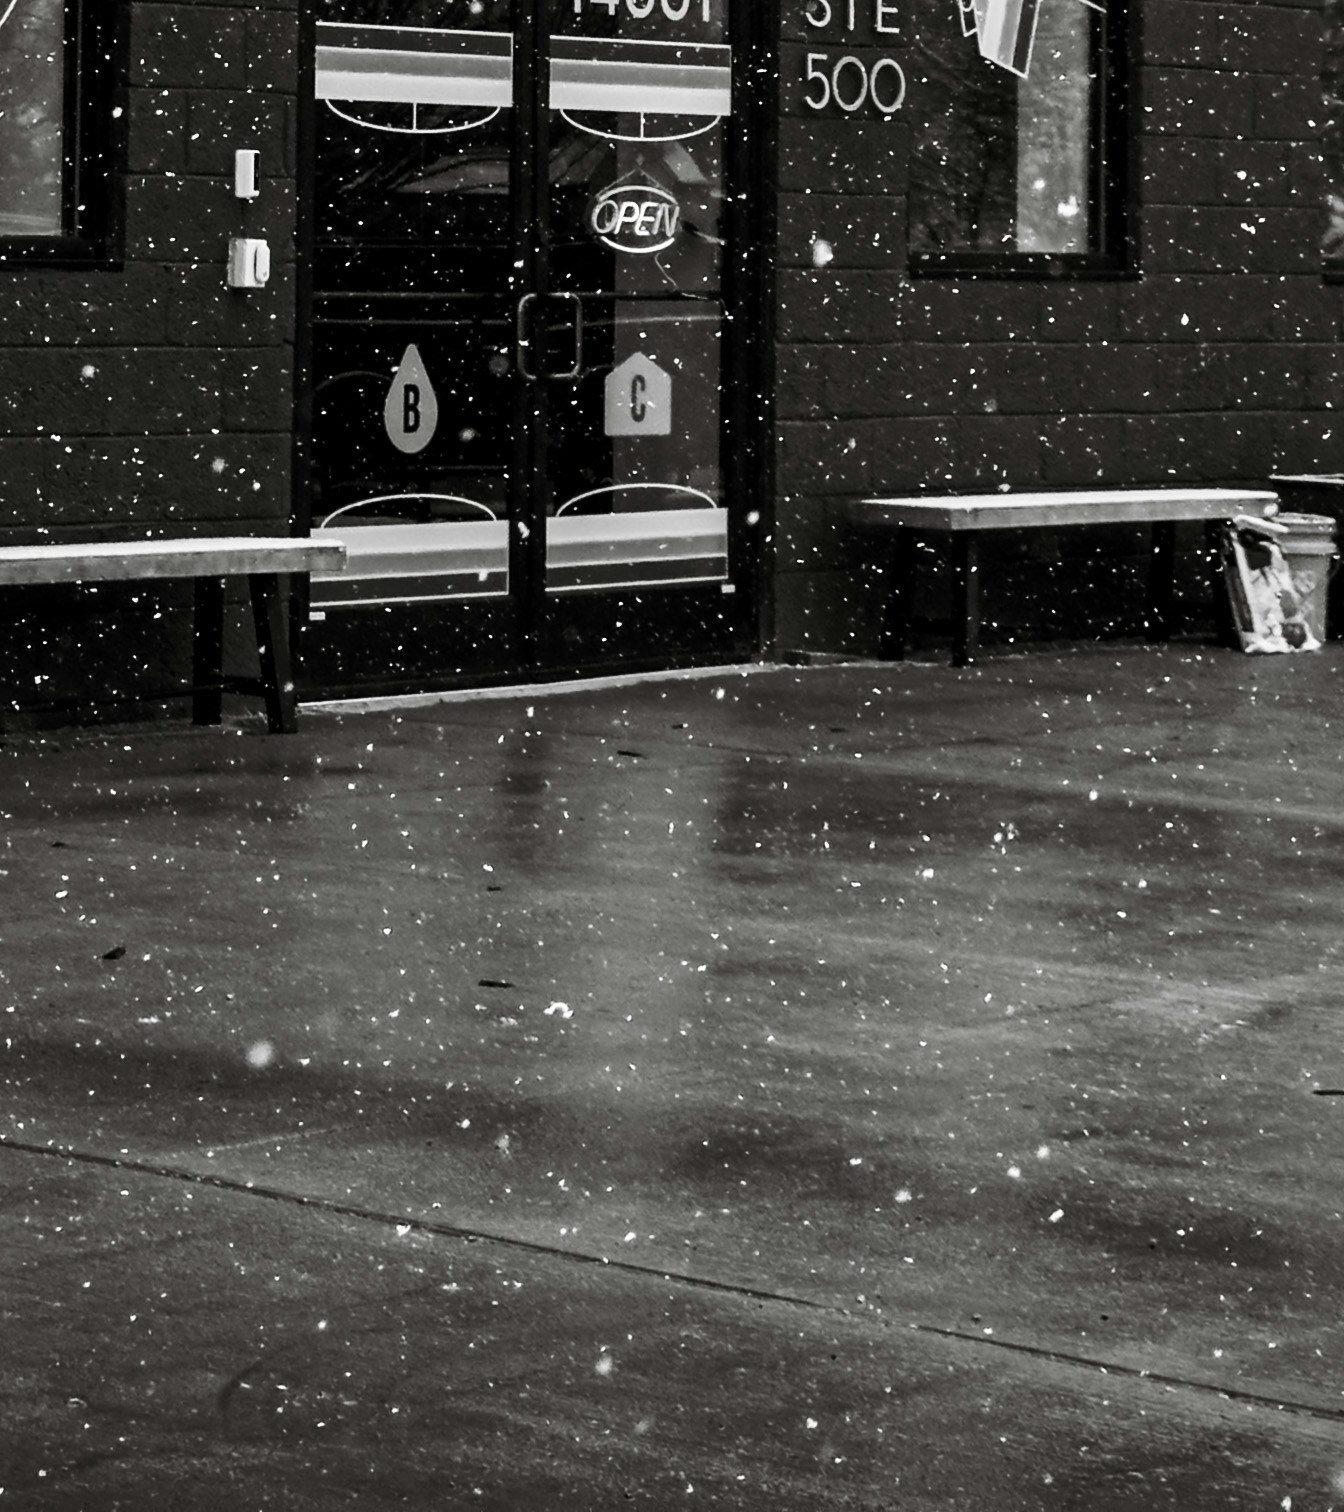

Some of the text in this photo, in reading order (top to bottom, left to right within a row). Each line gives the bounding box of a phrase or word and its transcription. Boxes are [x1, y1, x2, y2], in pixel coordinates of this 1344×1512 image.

[805, 52, 906, 113] 500
[592, 199, 680, 237] OPEN
[403, 384, 420, 434] B
[631, 375, 646, 423] C
